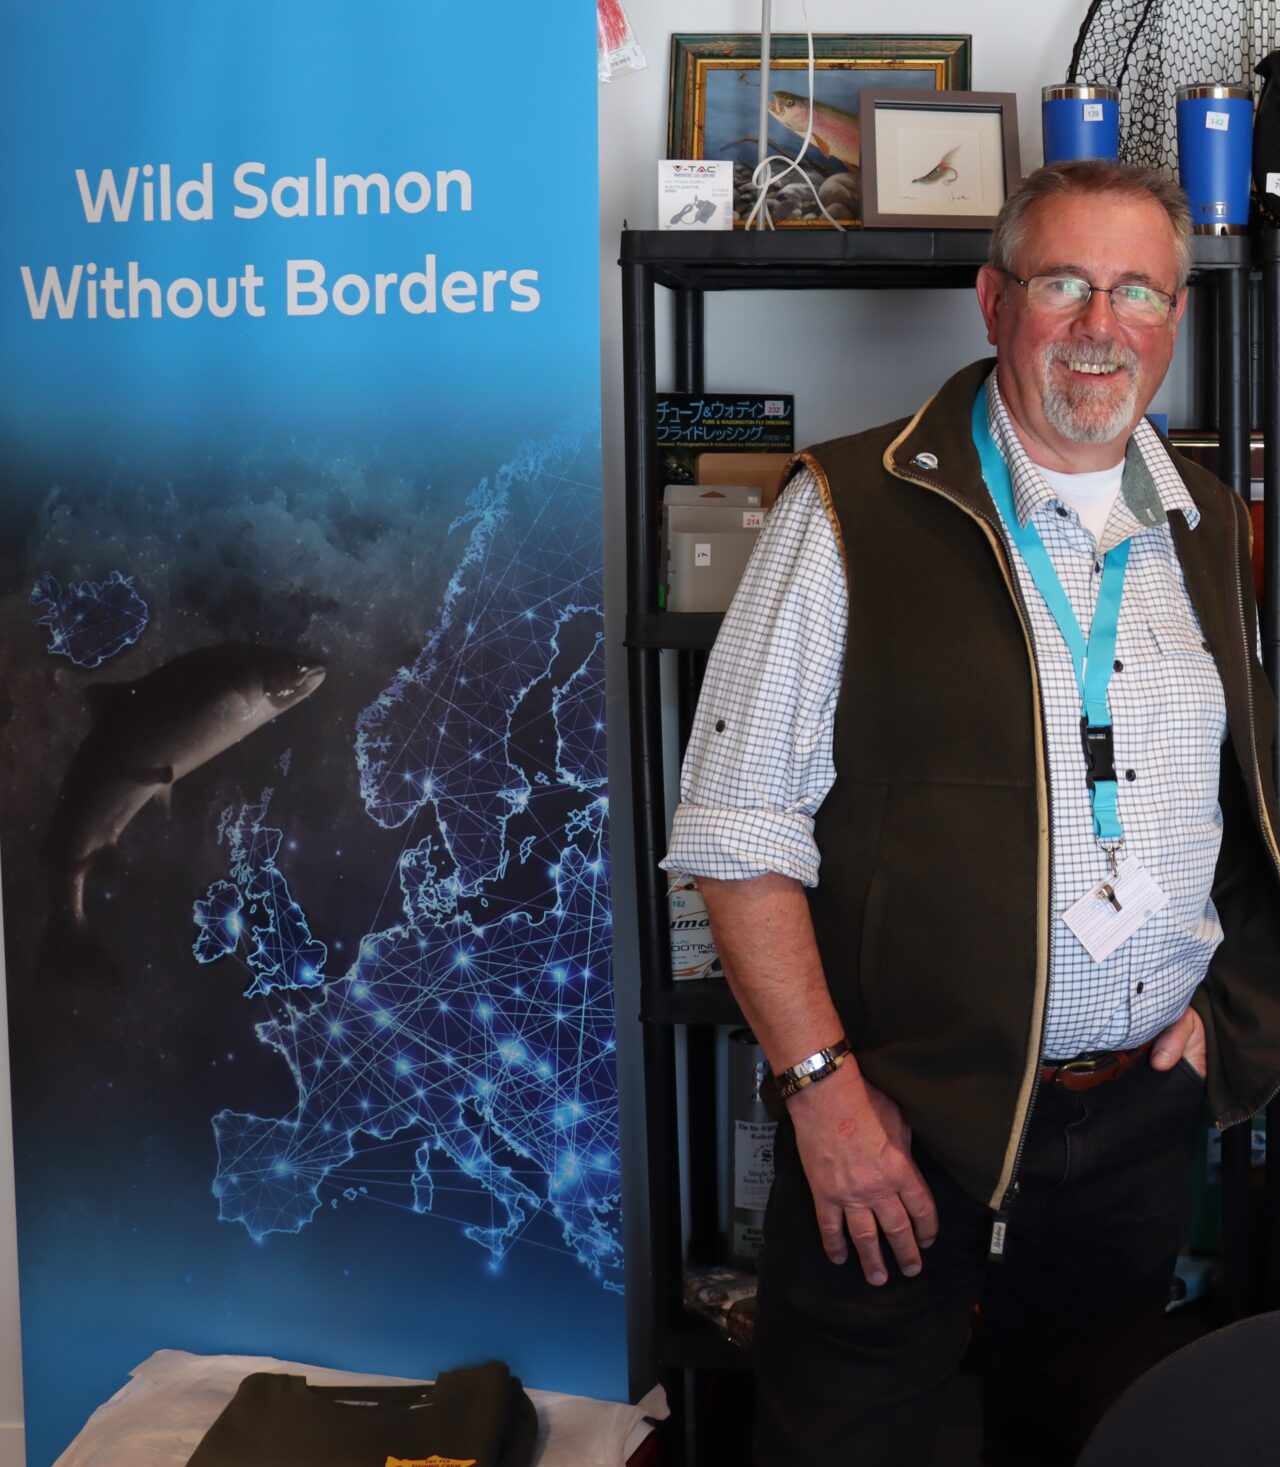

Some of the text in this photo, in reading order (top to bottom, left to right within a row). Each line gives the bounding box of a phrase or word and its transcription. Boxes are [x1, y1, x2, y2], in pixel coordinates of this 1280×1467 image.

[1210, 117, 1225, 127] 142
[673, 165, 716, 173] V-TAC
[75, 158, 473, 223] Wild Salmon
[20, 254, 541, 321] Without Borders
[767, 406, 781, 414] 232
[656, 426, 763, 441] フライドレッシング
[746, 518, 760, 526] 214
[672, 900, 686, 908] 182
